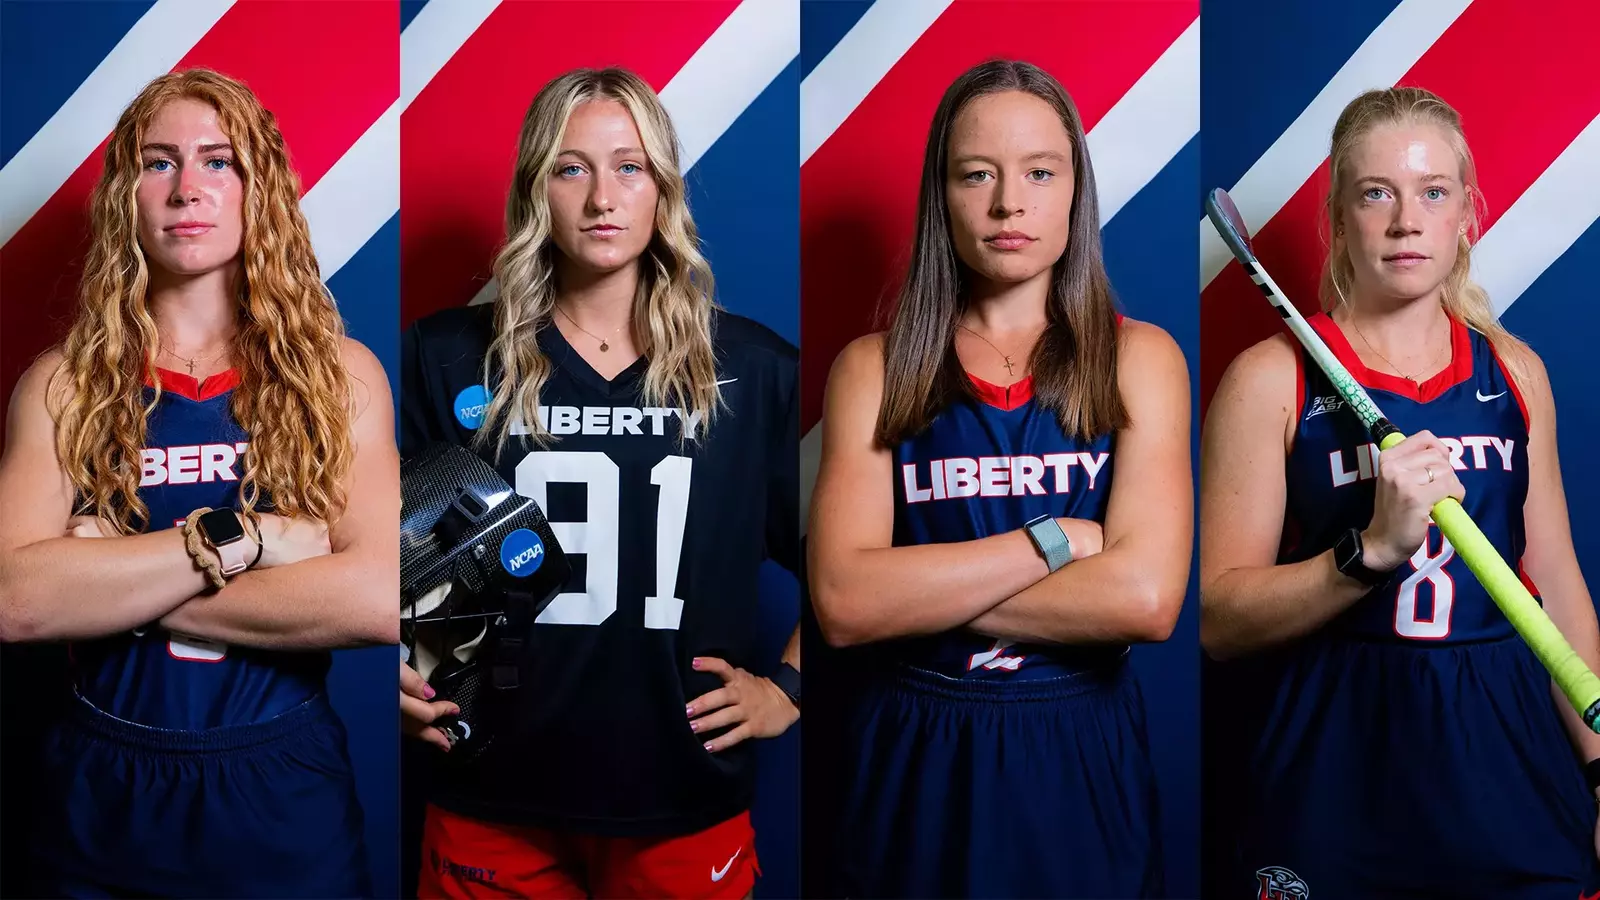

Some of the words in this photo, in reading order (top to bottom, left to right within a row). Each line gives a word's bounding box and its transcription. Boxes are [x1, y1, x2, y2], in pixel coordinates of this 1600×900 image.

[461, 404, 489, 420] NCA
[1313, 396, 1337, 405] BIG
[902, 452, 1109, 504] LIBERTY
[1329, 436, 1515, 488] LIRTY
[509, 543, 544, 571] NCAA
[515, 451, 693, 630] 91
[1393, 515, 1456, 640] 8
